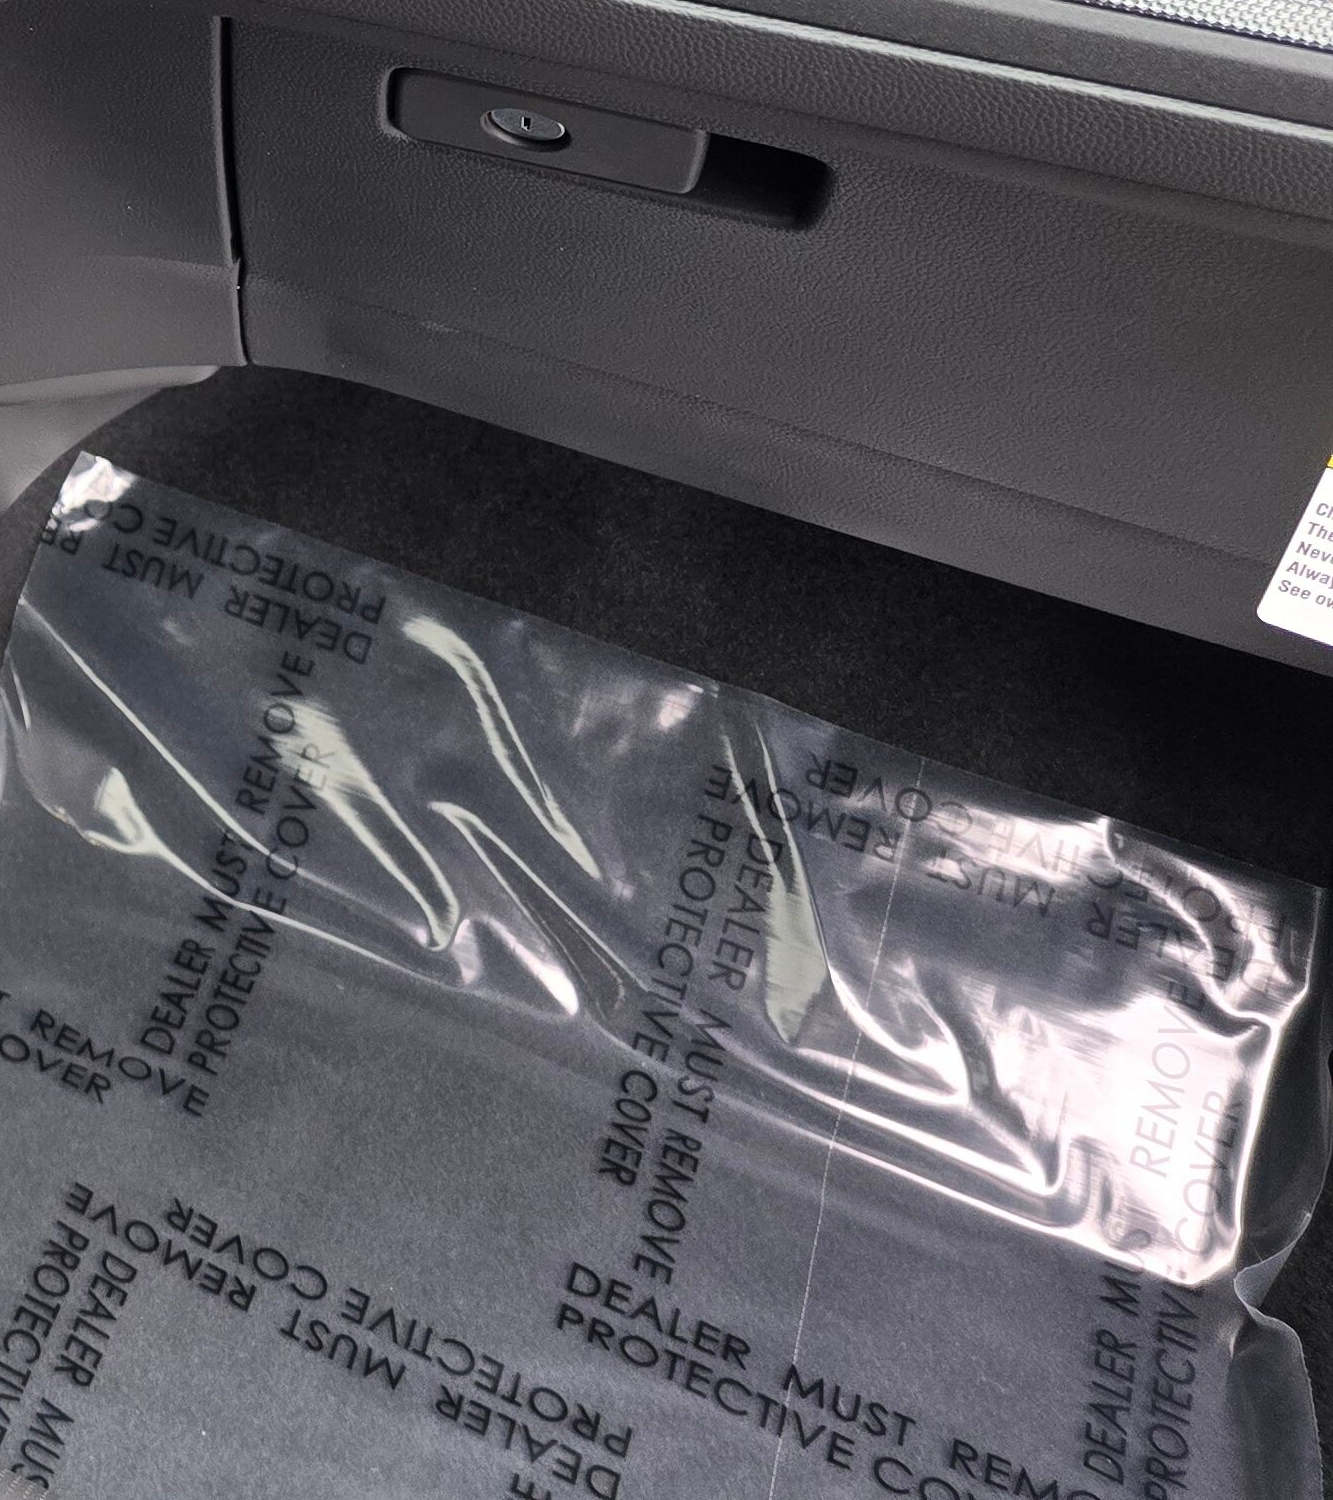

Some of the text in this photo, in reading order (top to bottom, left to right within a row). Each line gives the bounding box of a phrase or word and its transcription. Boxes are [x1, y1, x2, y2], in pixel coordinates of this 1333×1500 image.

[103, 544, 204, 598] MUST
[153, 517, 387, 624] PROTECTIVE
[225, 585, 372, 665] DEALER
[1278, 579, 1311, 600] See
[140, 650, 315, 1055] DEALER MUST REMOVE
[806, 753, 973, 833] COVER
[188, 742, 337, 1077] PROTECTIVE COVER
[927, 849, 1057, 918] MUST
[30, 1008, 210, 1117] REMOVE
[598, 812, 732, 1188] PROTECTIVE COVER
[633, 833, 784, 1286] DEALER MUST REMOVE
[53, 1250, 138, 1387] DEALER
[65, 1181, 623, 1500] DEALER MUST REMOVE
[166, 1196, 634, 1459] PROTECTIVE COVER
[556, 1303, 856, 1470] PROTECTIVE
[566, 1262, 752, 1370] DEALER
[782, 1364, 916, 1446] MUST
[1082, 1328, 1138, 1485] DEALER
